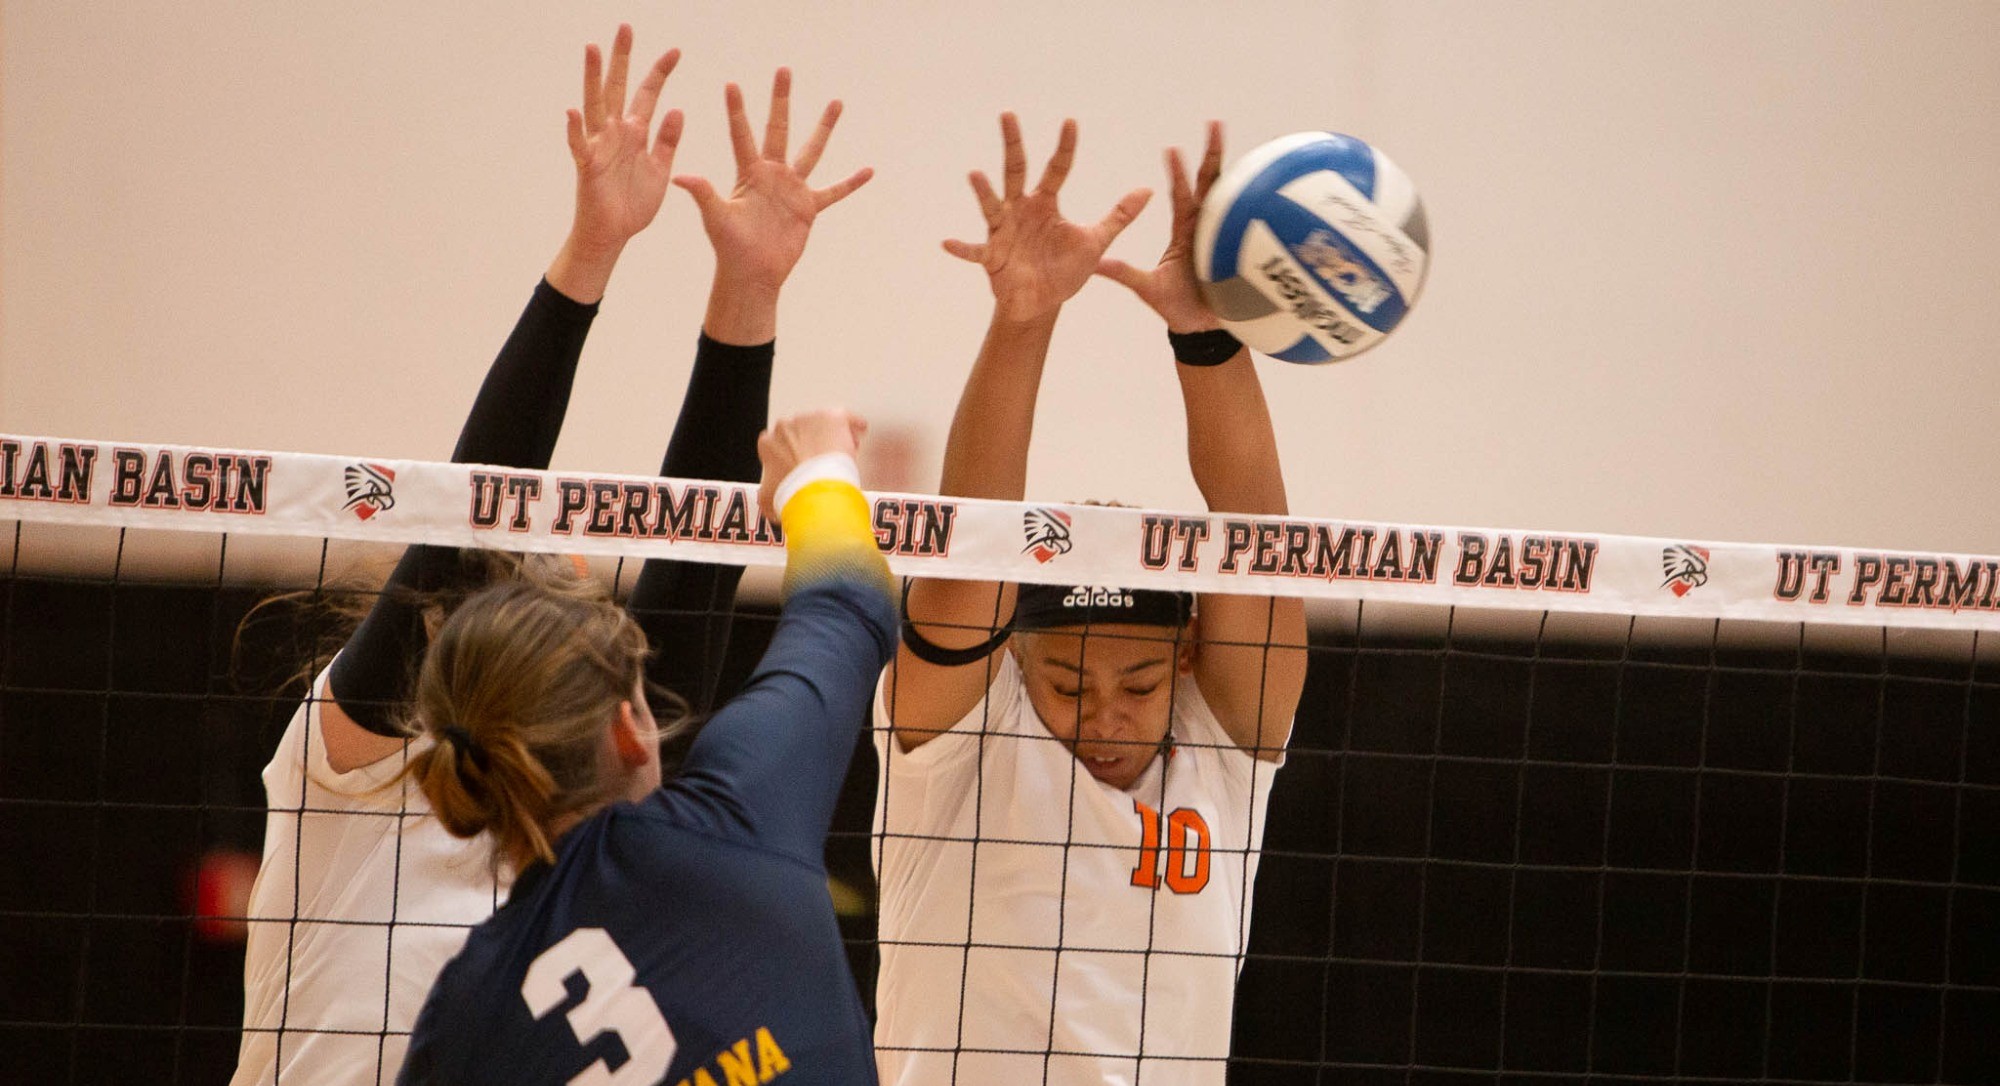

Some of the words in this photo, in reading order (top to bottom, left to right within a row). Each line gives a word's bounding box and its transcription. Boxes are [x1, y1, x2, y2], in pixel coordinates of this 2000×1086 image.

[0, 438, 98, 504] IAN
[108, 447, 272, 514] BASIN
[469, 470, 542, 536] UT
[872, 498, 958, 558] SIN
[1138, 515, 1210, 573] UT
[1218, 518, 1446, 585] PERMIAN
[1452, 530, 1599, 594] BASIN
[1773, 549, 1842, 604] UT
[1847, 550, 2000, 615] PERMI
[1062, 587, 1134, 608] adidas
[1130, 799, 1211, 895] 10
[520, 927, 678, 1086] 3
